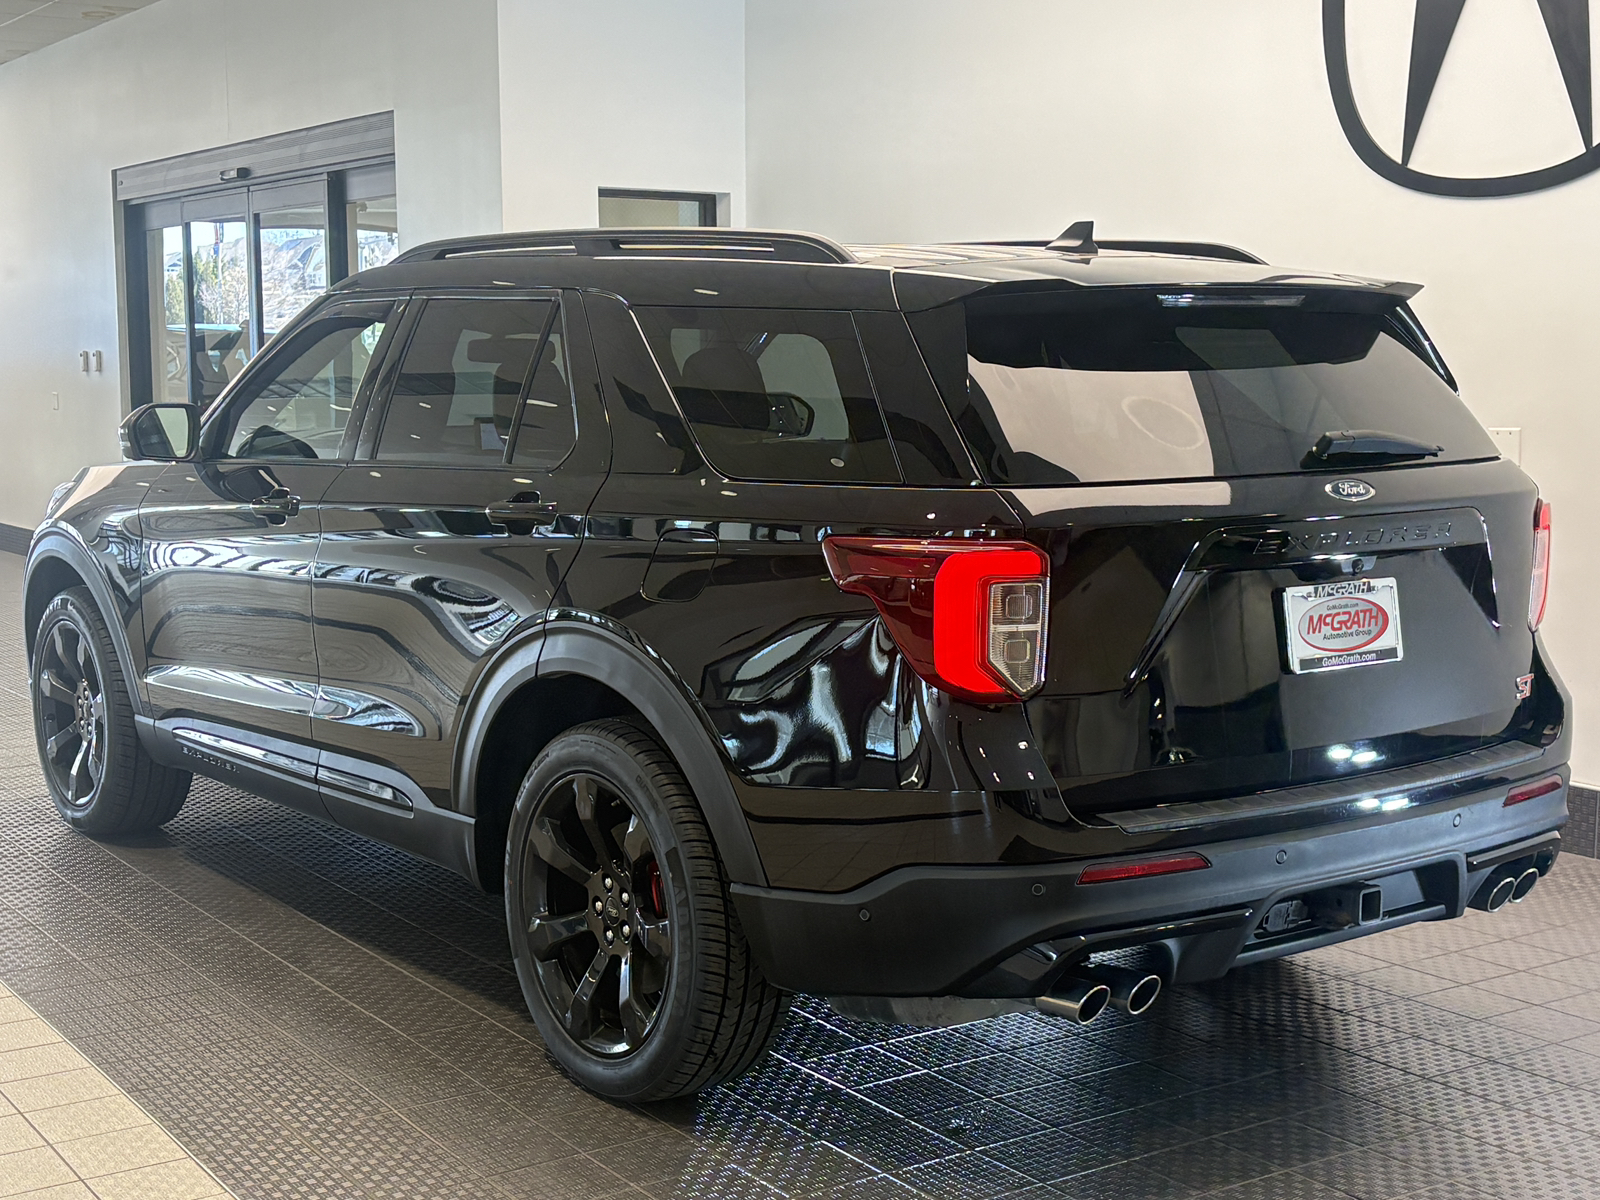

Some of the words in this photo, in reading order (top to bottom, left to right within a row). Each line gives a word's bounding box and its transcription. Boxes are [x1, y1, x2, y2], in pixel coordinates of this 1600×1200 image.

[1338, 482, 1366, 496] Ford
[1253, 522, 1452, 556] EXPLORER
[1326, 602, 1359, 611] GoMcGrath.com
[1323, 630, 1354, 641] Automotive
[1354, 628, 1373, 637] Group
[1322, 652, 1377, 666] GoMcGrath.com
[1515, 673, 1535, 700] ST
